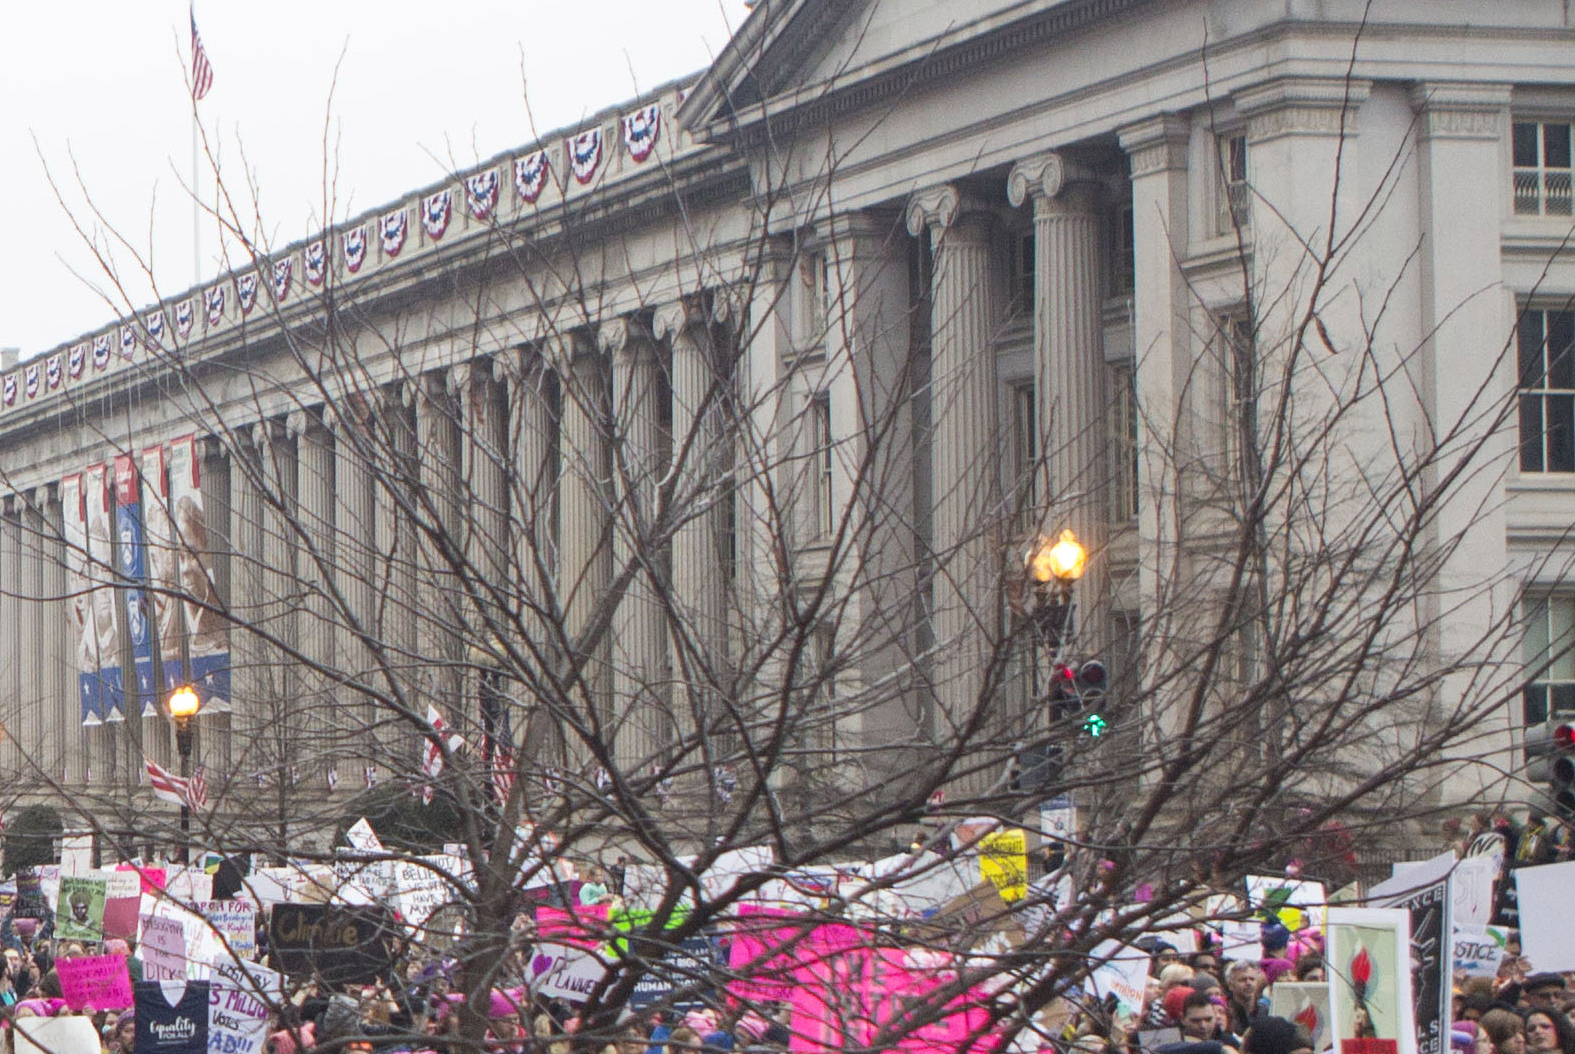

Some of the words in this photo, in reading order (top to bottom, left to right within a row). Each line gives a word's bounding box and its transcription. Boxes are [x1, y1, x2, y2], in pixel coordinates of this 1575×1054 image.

[403, 868, 435, 881] BELIE
[217, 963, 244, 982] LOST
[254, 974, 272, 990] BY
[545, 956, 595, 995] PLANNE
[633, 981, 673, 992] HUMAN
[209, 983, 223, 1005] 3
[150, 1015, 195, 1037] Equality
